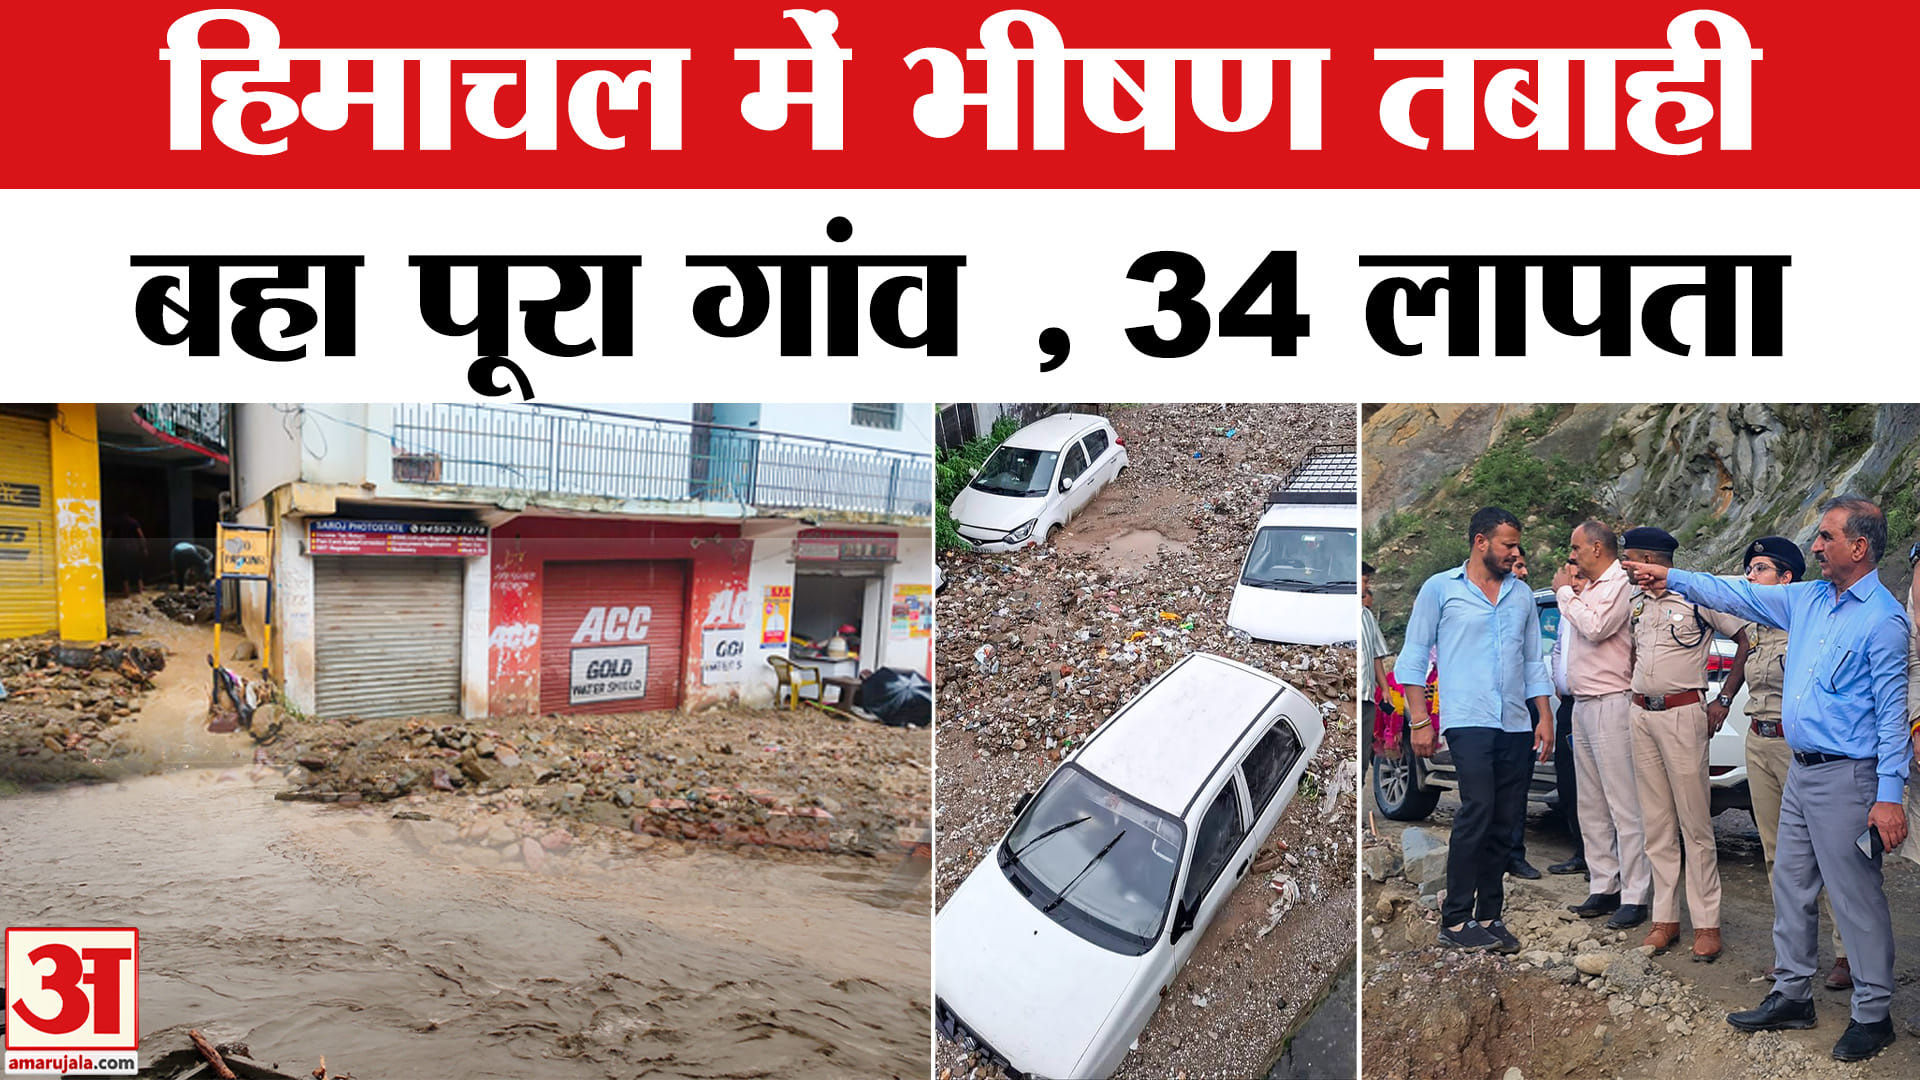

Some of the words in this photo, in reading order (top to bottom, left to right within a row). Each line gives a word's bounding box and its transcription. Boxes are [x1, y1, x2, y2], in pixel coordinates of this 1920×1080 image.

[316, 521, 346, 530] SAROJ
[348, 522, 404, 534] PHOTOSTATE
[571, 605, 653, 643] ACC
[586, 658, 633, 680] GOLD
[572, 683, 606, 696] WATER
[606, 680, 642, 693] SHIELD
